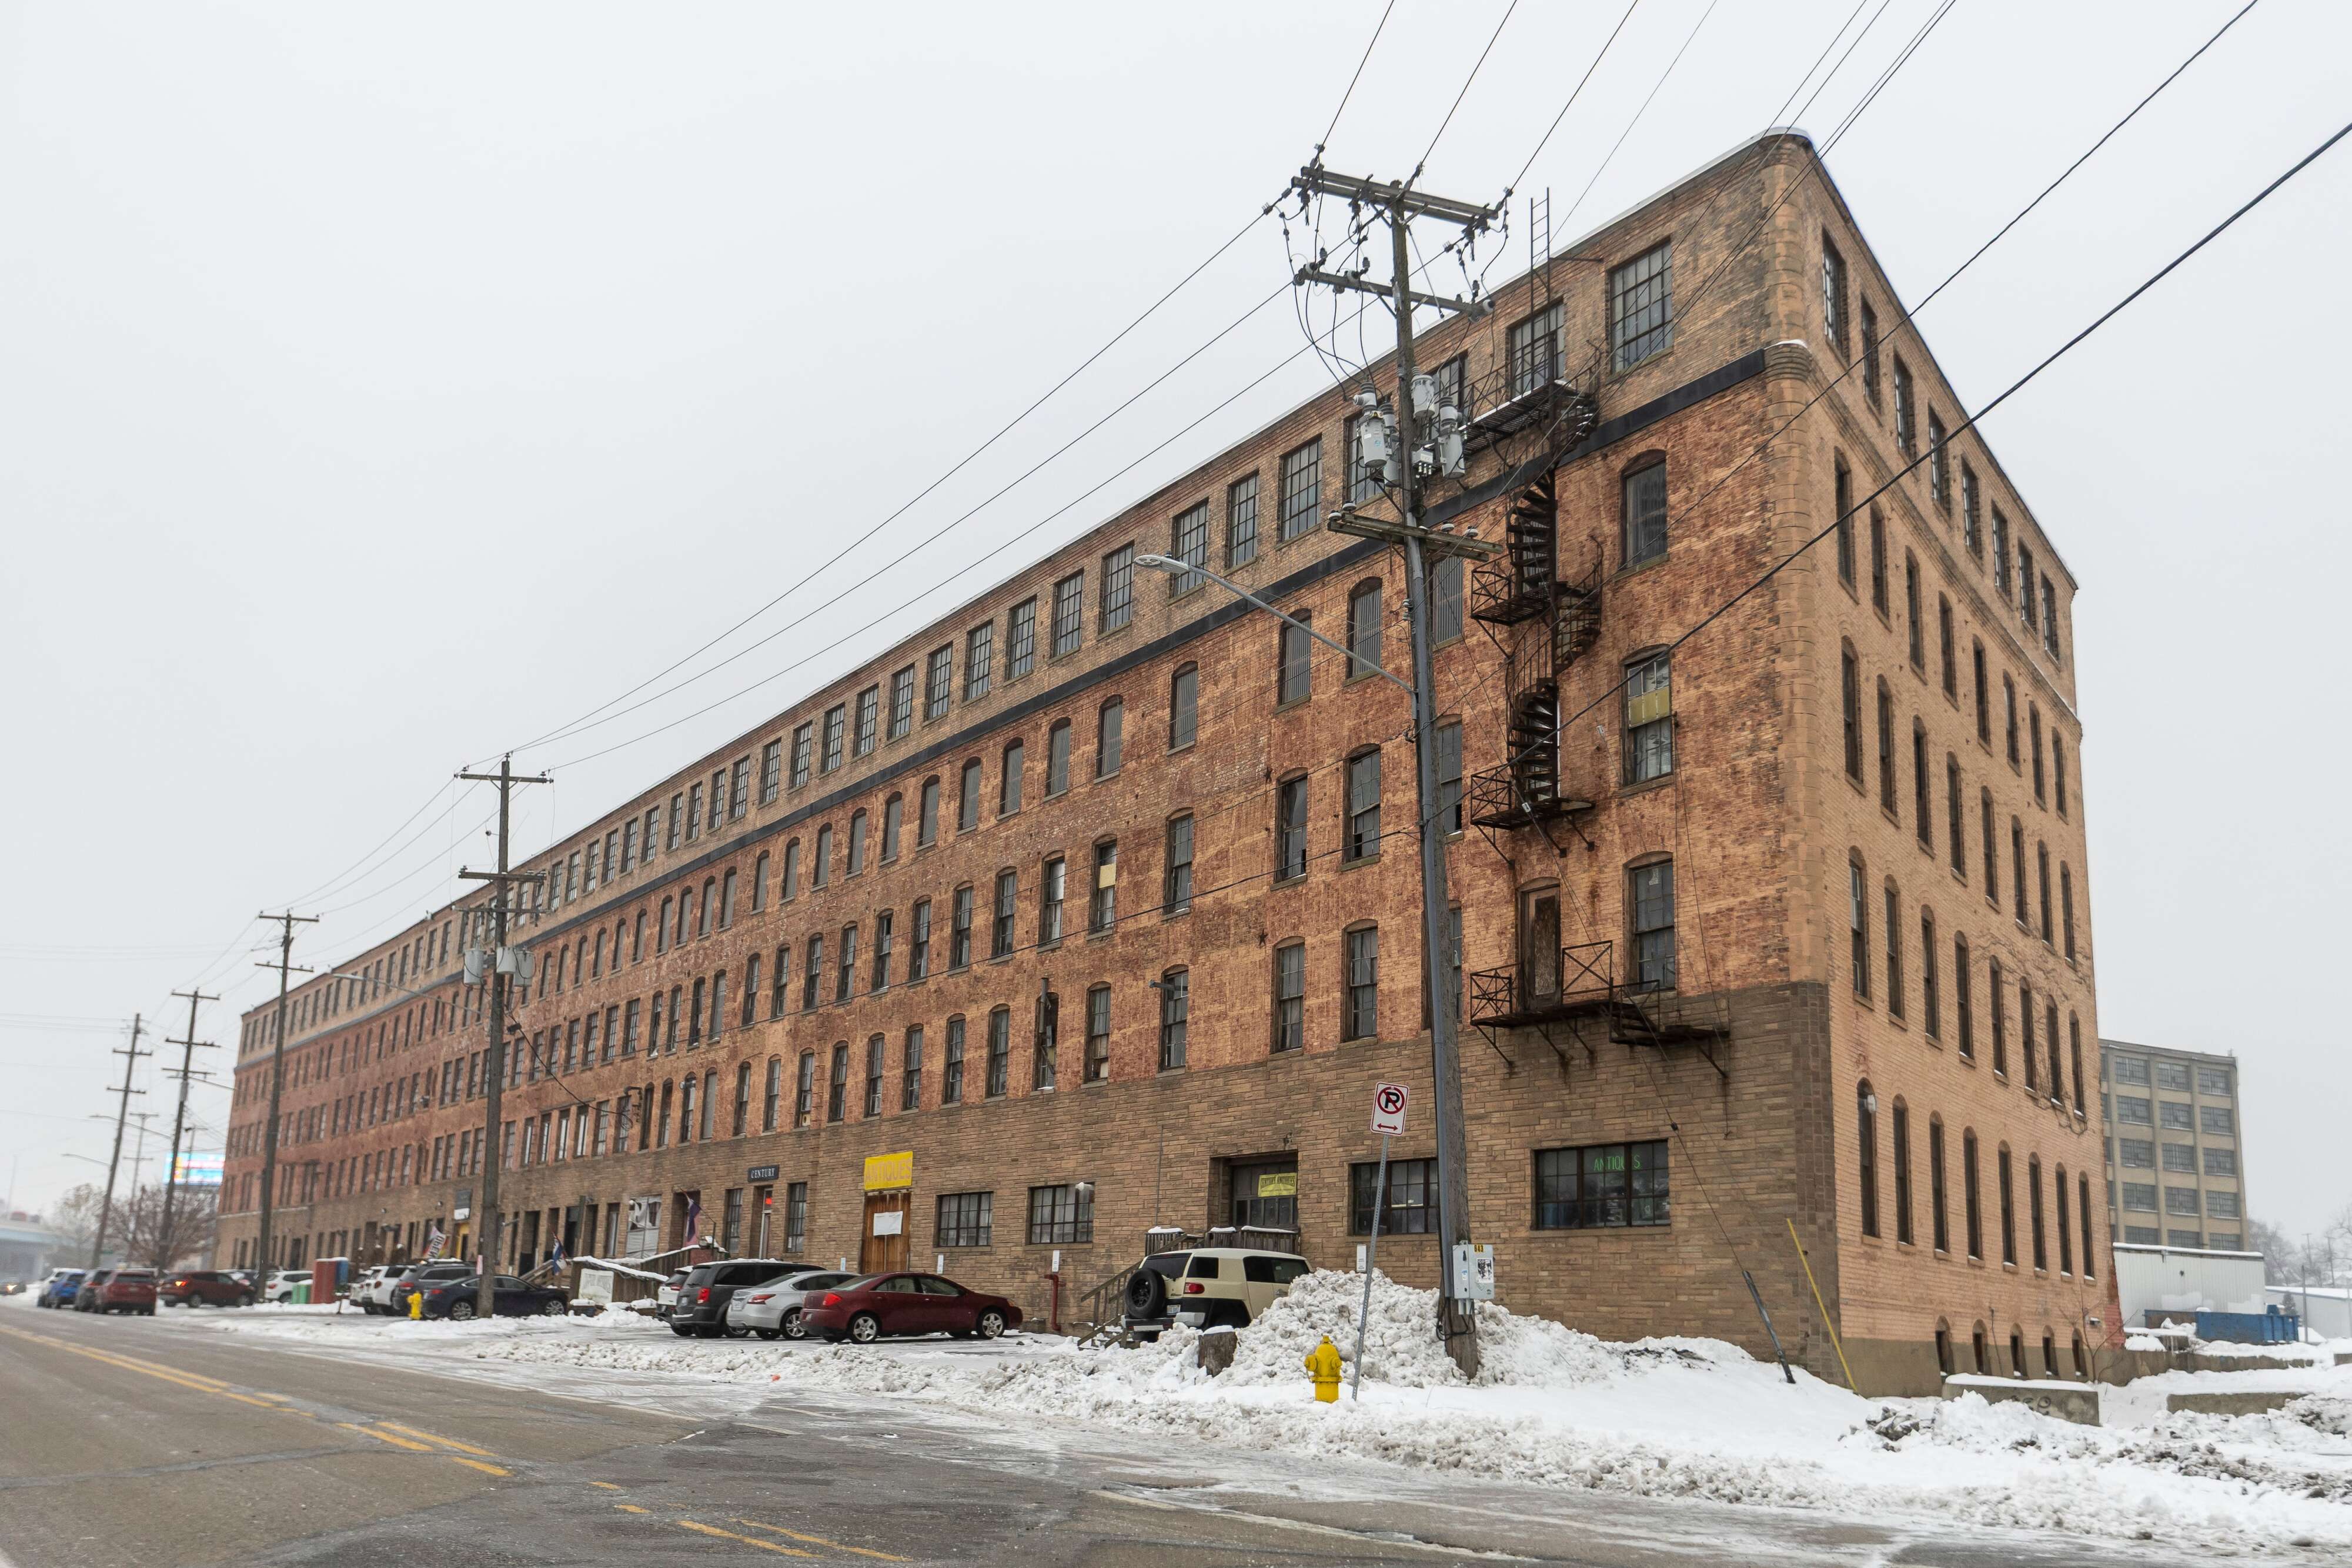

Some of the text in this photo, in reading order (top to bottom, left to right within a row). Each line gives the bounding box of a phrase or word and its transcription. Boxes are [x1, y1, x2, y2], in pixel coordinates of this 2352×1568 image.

[866, 1157, 912, 1182] ANTIQUES
[1593, 1155, 1641, 1171] ANTIQUS
[751, 1168, 776, 1179] CENTURY
